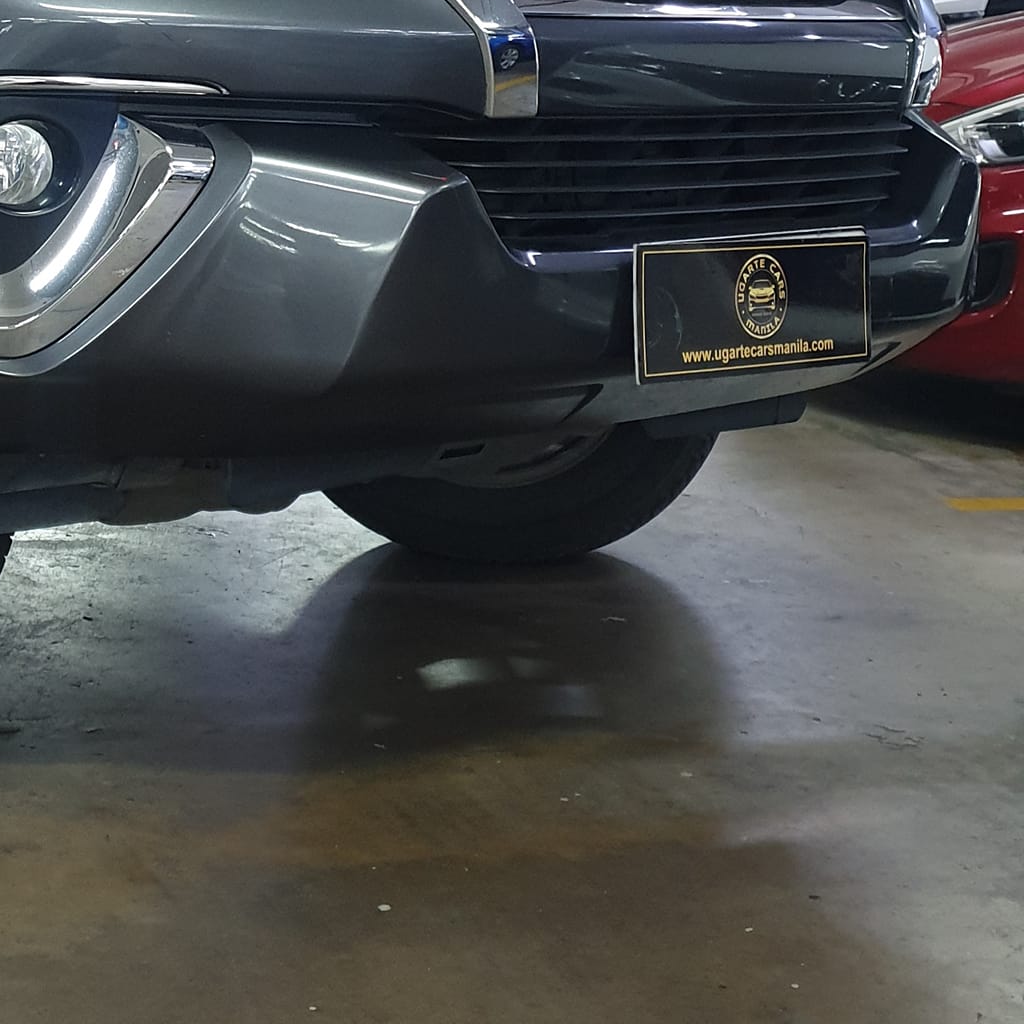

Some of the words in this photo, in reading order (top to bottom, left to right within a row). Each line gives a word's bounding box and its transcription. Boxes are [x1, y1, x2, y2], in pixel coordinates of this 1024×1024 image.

[737, 258, 766, 304] UGARTE
[769, 263, 786, 300] CARS
[745, 316, 781, 335] MANILA
[682, 338, 834, 364] www.ugartecarsmanila.com
